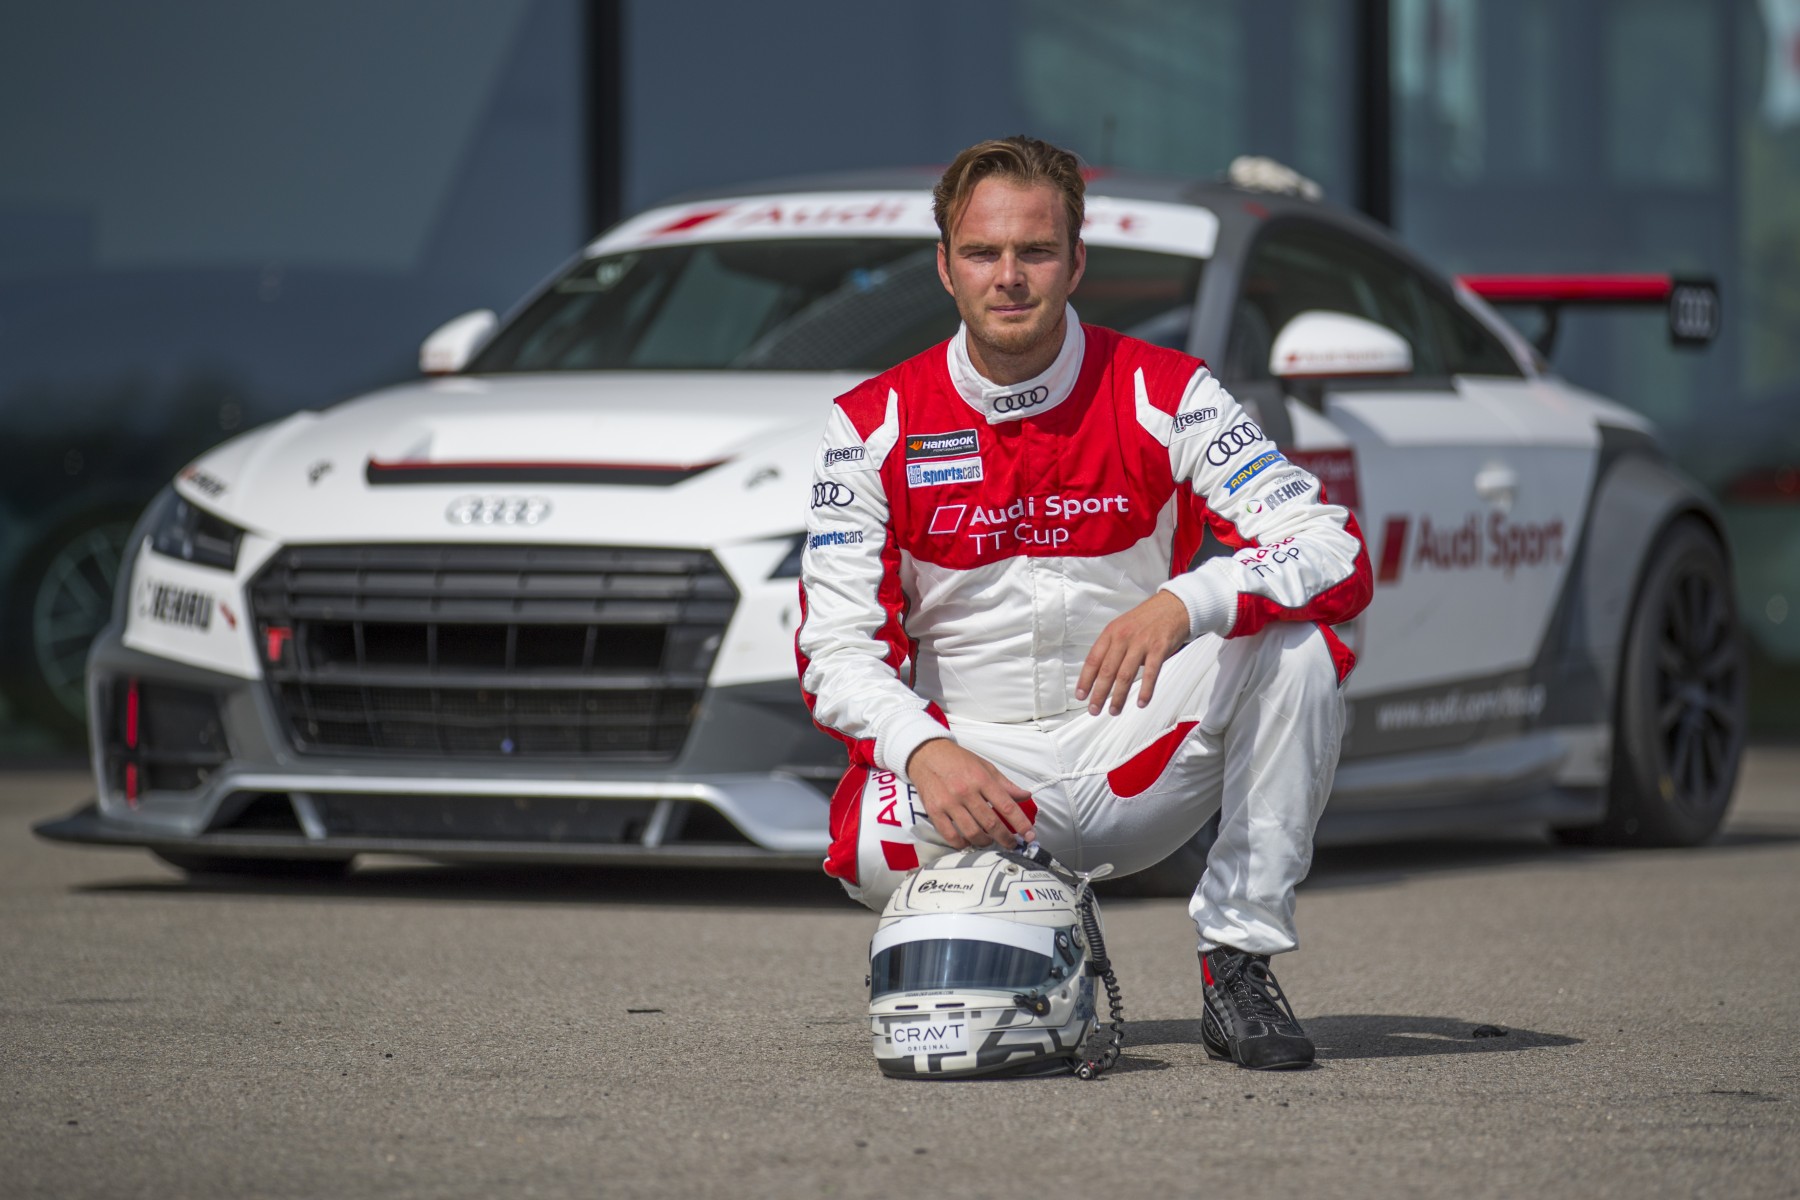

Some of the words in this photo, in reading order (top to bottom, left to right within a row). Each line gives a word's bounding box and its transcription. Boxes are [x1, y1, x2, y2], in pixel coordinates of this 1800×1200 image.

[969, 497, 1034, 526] Audi
[1045, 495, 1129, 520] Sport
[1264, 479, 1313, 511] REHAU
[968, 530, 1007, 555] TT
[1014, 522, 1069, 548] Cup
[872, 770, 902, 828] Audi
[1034, 888, 1069, 903] NIBC
[894, 1024, 964, 1043] CRAVT
[907, 1044, 950, 1052] ORIGINAL
